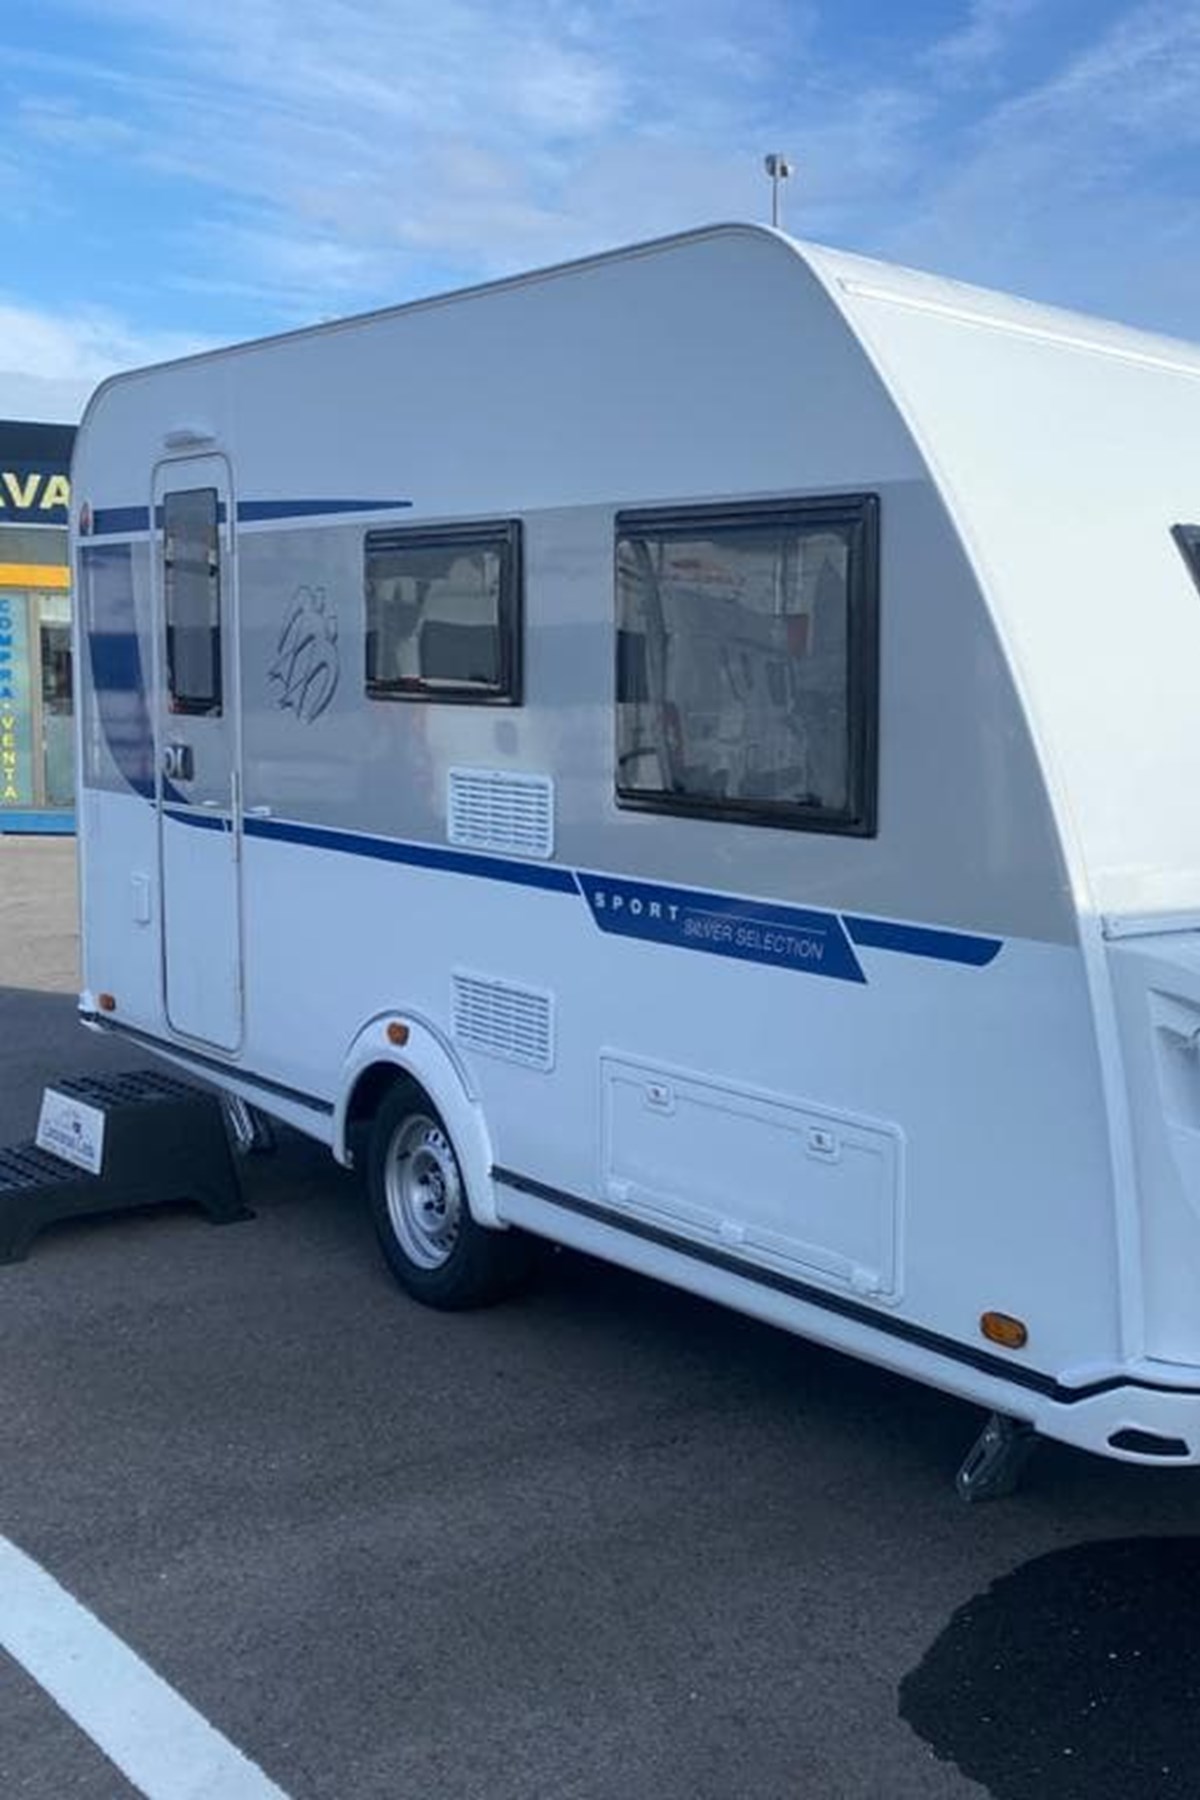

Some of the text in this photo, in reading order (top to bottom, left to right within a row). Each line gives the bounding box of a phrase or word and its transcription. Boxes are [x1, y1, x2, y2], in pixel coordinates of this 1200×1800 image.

[0, 472, 70, 509] VA
[1, 714, 19, 801] VENTA
[595, 891, 679, 920] SPORT
[683, 917, 825, 961] SILVER SELECTION
